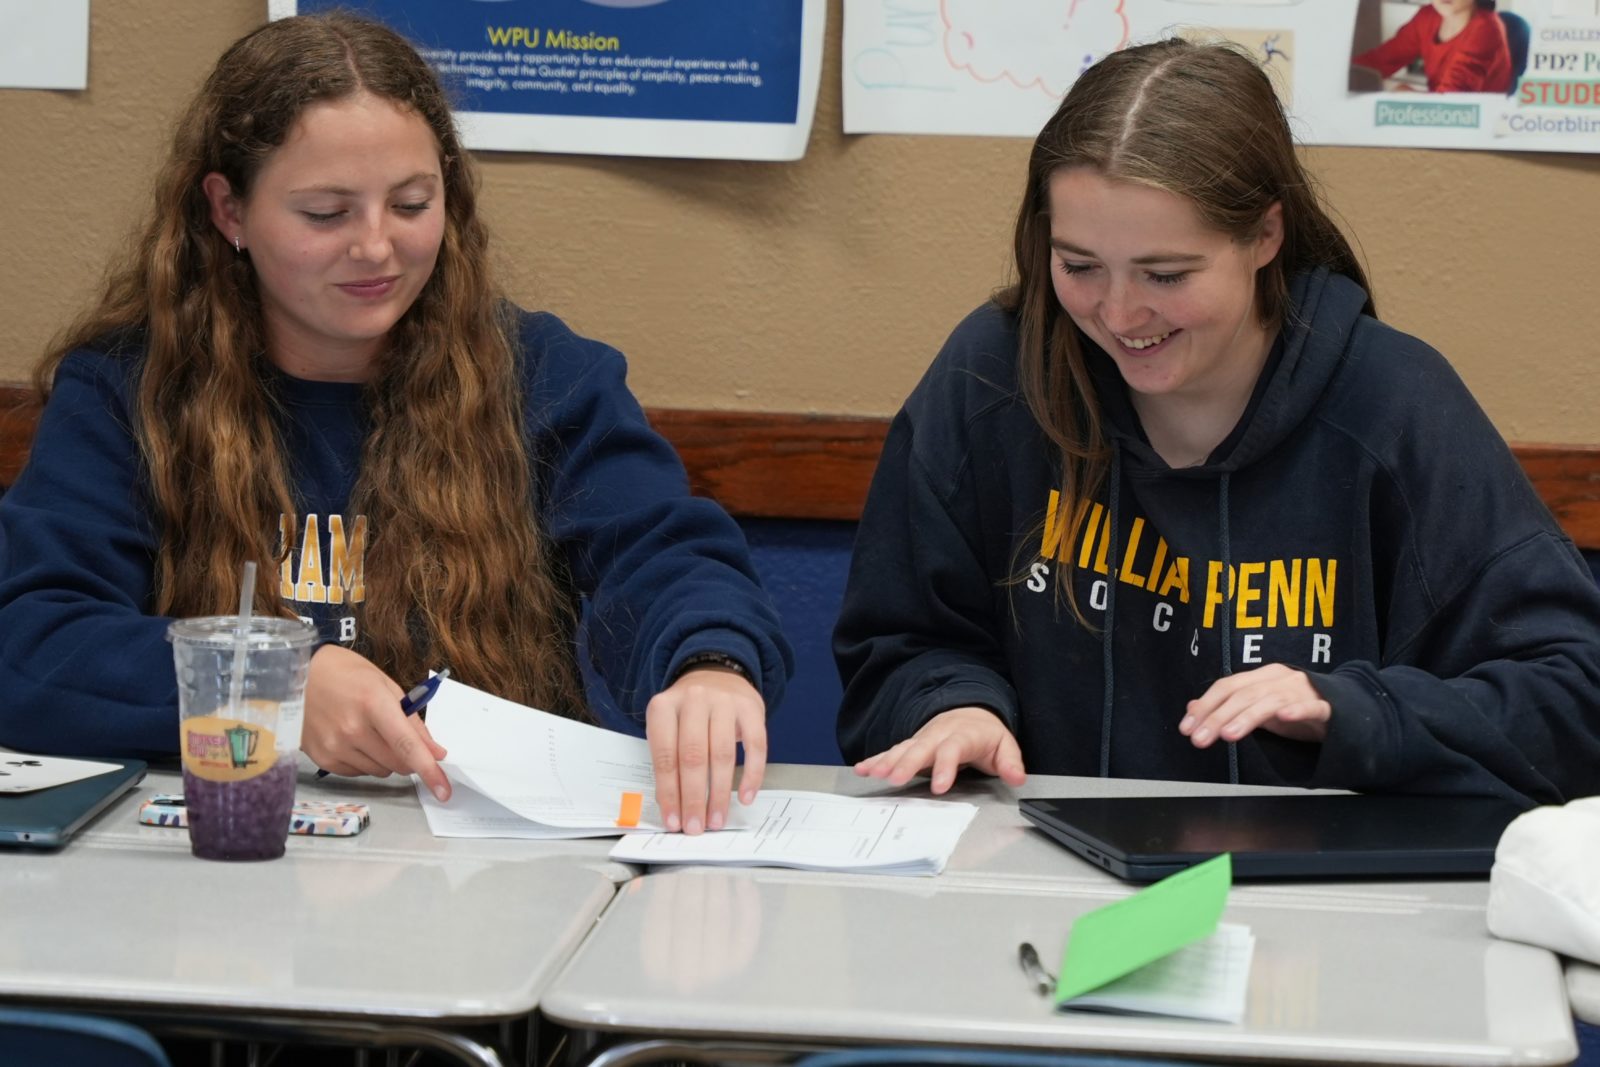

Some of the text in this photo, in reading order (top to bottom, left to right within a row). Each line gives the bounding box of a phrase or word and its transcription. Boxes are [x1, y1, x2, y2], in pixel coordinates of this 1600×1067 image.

[487, 26, 620, 51] WPU Mission
[459, 50, 503, 63] provides
[505, 51, 520, 62] the
[522, 53, 580, 66] opportunity
[582, 53, 597, 65] for
[599, 56, 612, 66] an
[614, 55, 672, 68] educational
[674, 59, 727, 71] experience
[728, 59, 748, 70] with
[750, 61, 759, 71] a
[1534, 53, 1578, 72] PD?
[466, 78, 509, 91] integrity,
[512, 80, 568, 93] community,
[571, 82, 593, 92] and
[498, 65, 518, 76] and
[521, 65, 536, 77] the
[538, 65, 576, 78] Quaker
[579, 68, 627, 81] principles
[629, 69, 641, 80] of
[642, 70, 686, 84] simplicity,
[689, 72, 763, 87] peace-making,
[1377, 104, 1478, 126] Professional
[1041, 488, 1338, 629] WILLIA PENN
